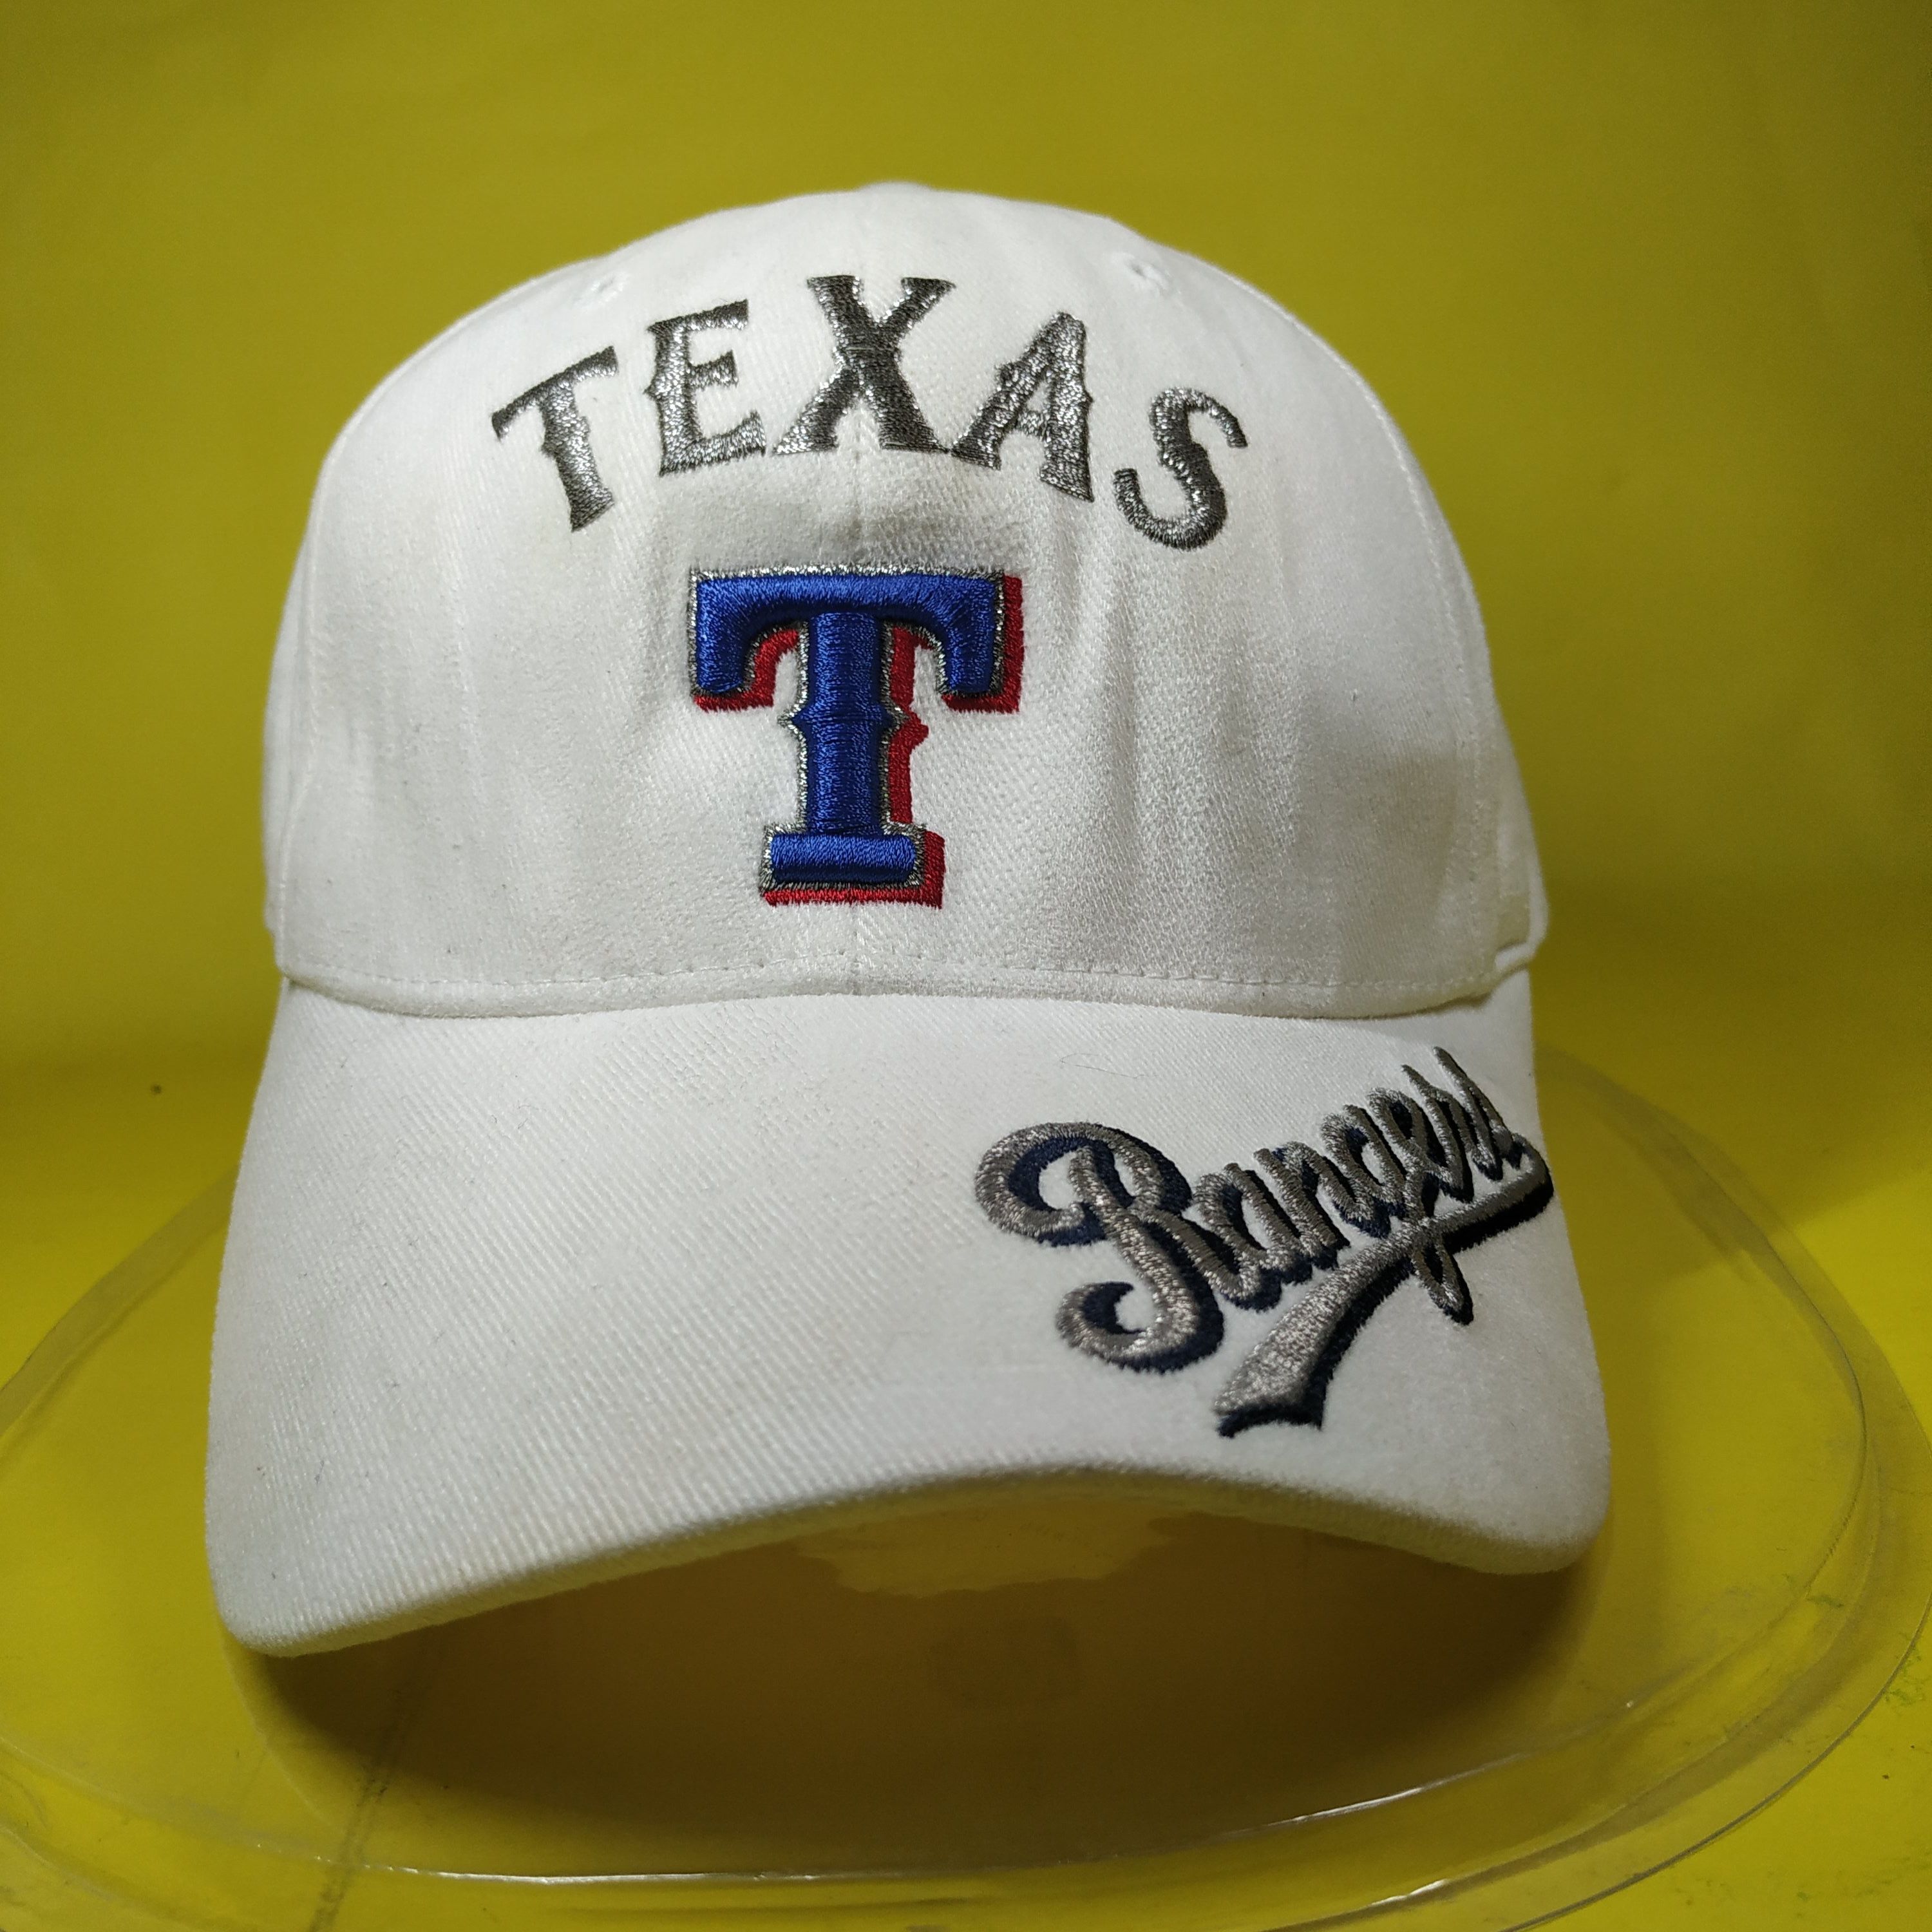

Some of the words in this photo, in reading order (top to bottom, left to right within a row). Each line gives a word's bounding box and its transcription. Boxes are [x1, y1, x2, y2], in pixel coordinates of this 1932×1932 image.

[491, 274, 1249, 551] TEXAS
[688, 564, 1025, 909] T
[974, 1046, 1554, 1438] Rangers
